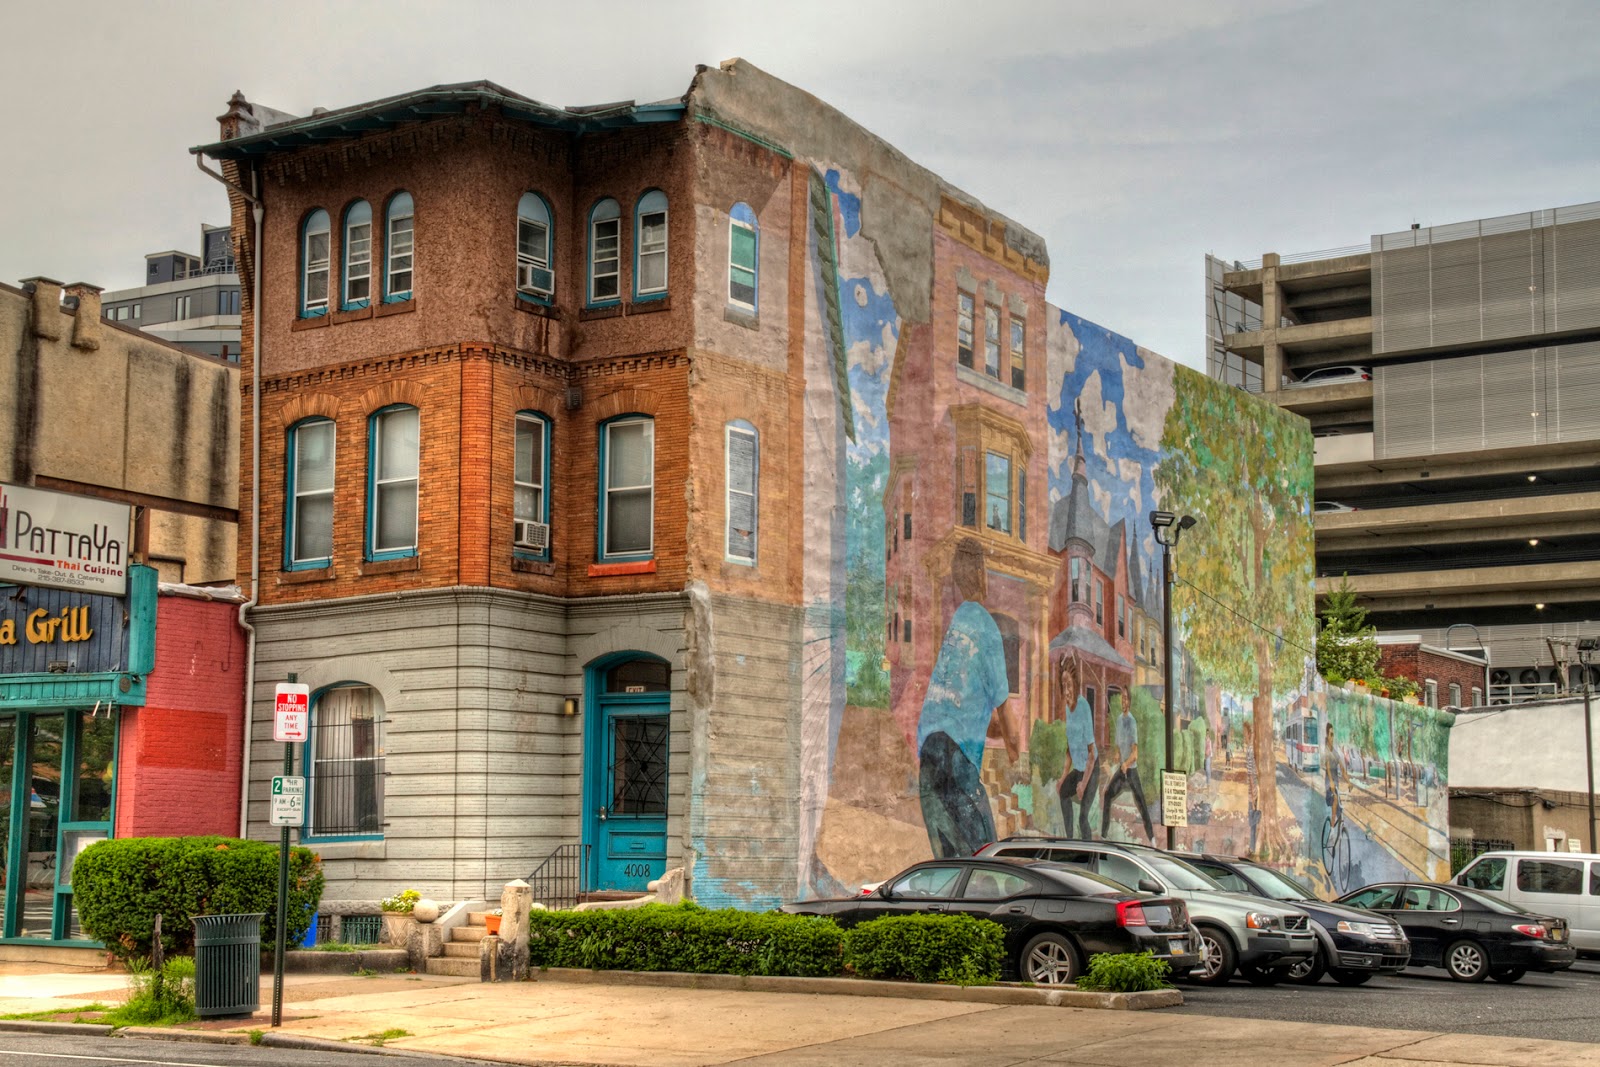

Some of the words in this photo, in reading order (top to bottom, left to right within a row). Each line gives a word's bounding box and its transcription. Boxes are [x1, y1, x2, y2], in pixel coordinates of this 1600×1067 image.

[56, 560, 81, 571] Thai
[83, 564, 123, 577] Cuisine
[77, 574, 105, 584] Catering
[25, 605, 94, 645] Grill
[287, 693, 298, 703] NO
[278, 703, 306, 712] STOPPING
[284, 722, 298, 730] TIME
[274, 780, 281, 793] 2
[290, 796, 296, 807] 6
[624, 863, 651, 878] 4008
